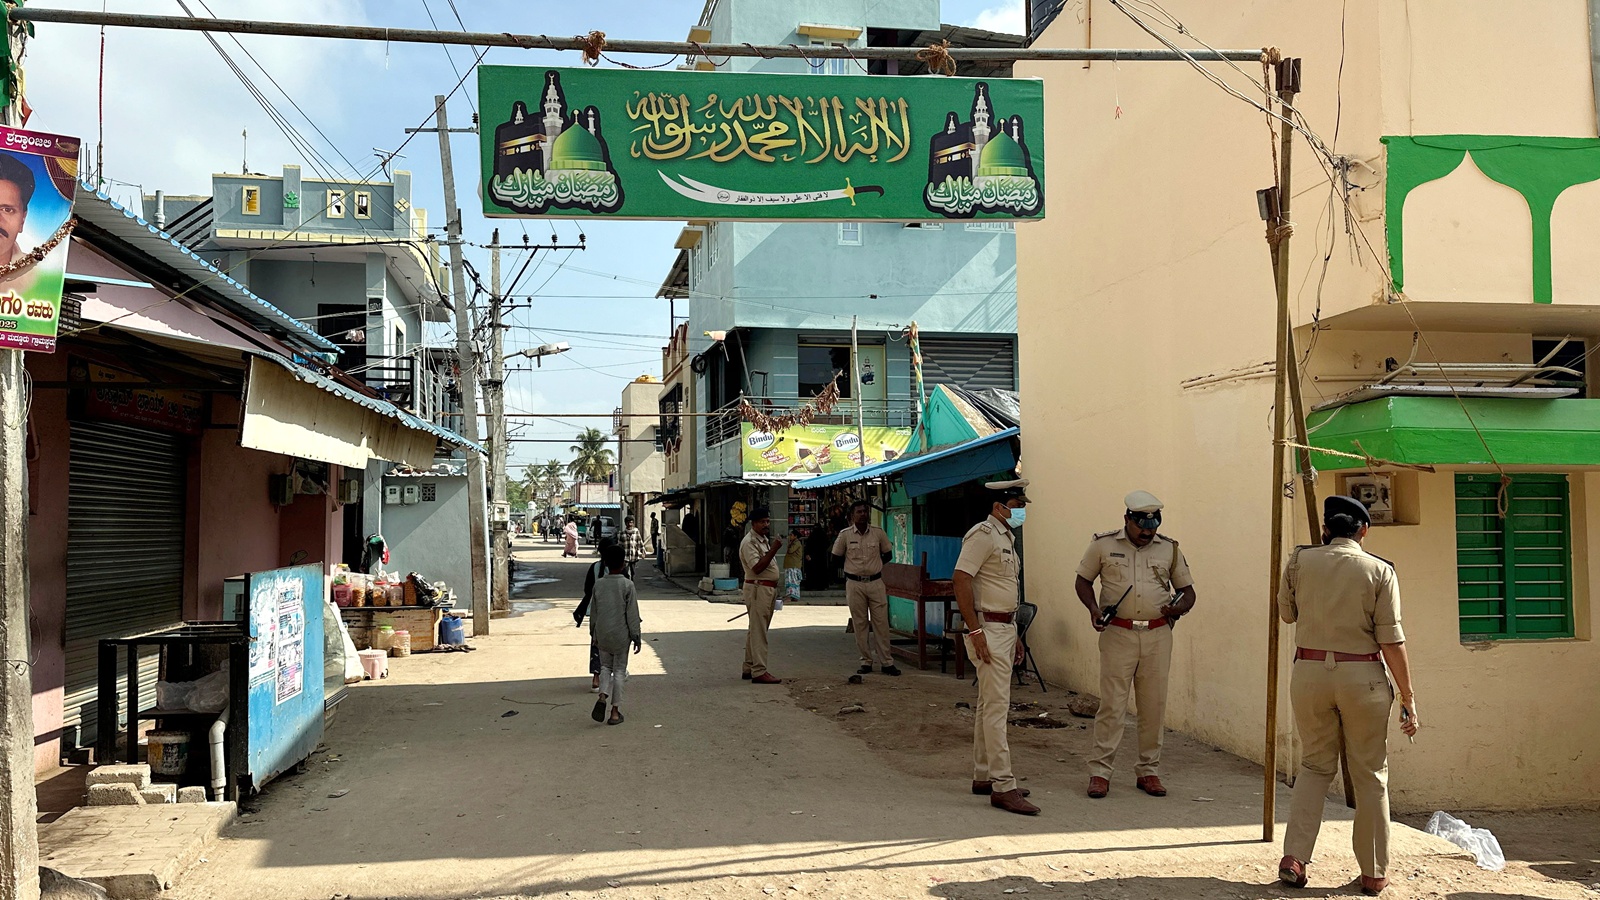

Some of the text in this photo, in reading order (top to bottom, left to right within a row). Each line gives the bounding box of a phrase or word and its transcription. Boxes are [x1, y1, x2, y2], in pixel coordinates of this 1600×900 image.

[27, 301, 53, 319] ರವರು
[749, 434, 773, 446] Bindu
[835, 437, 859, 449] Bindu
